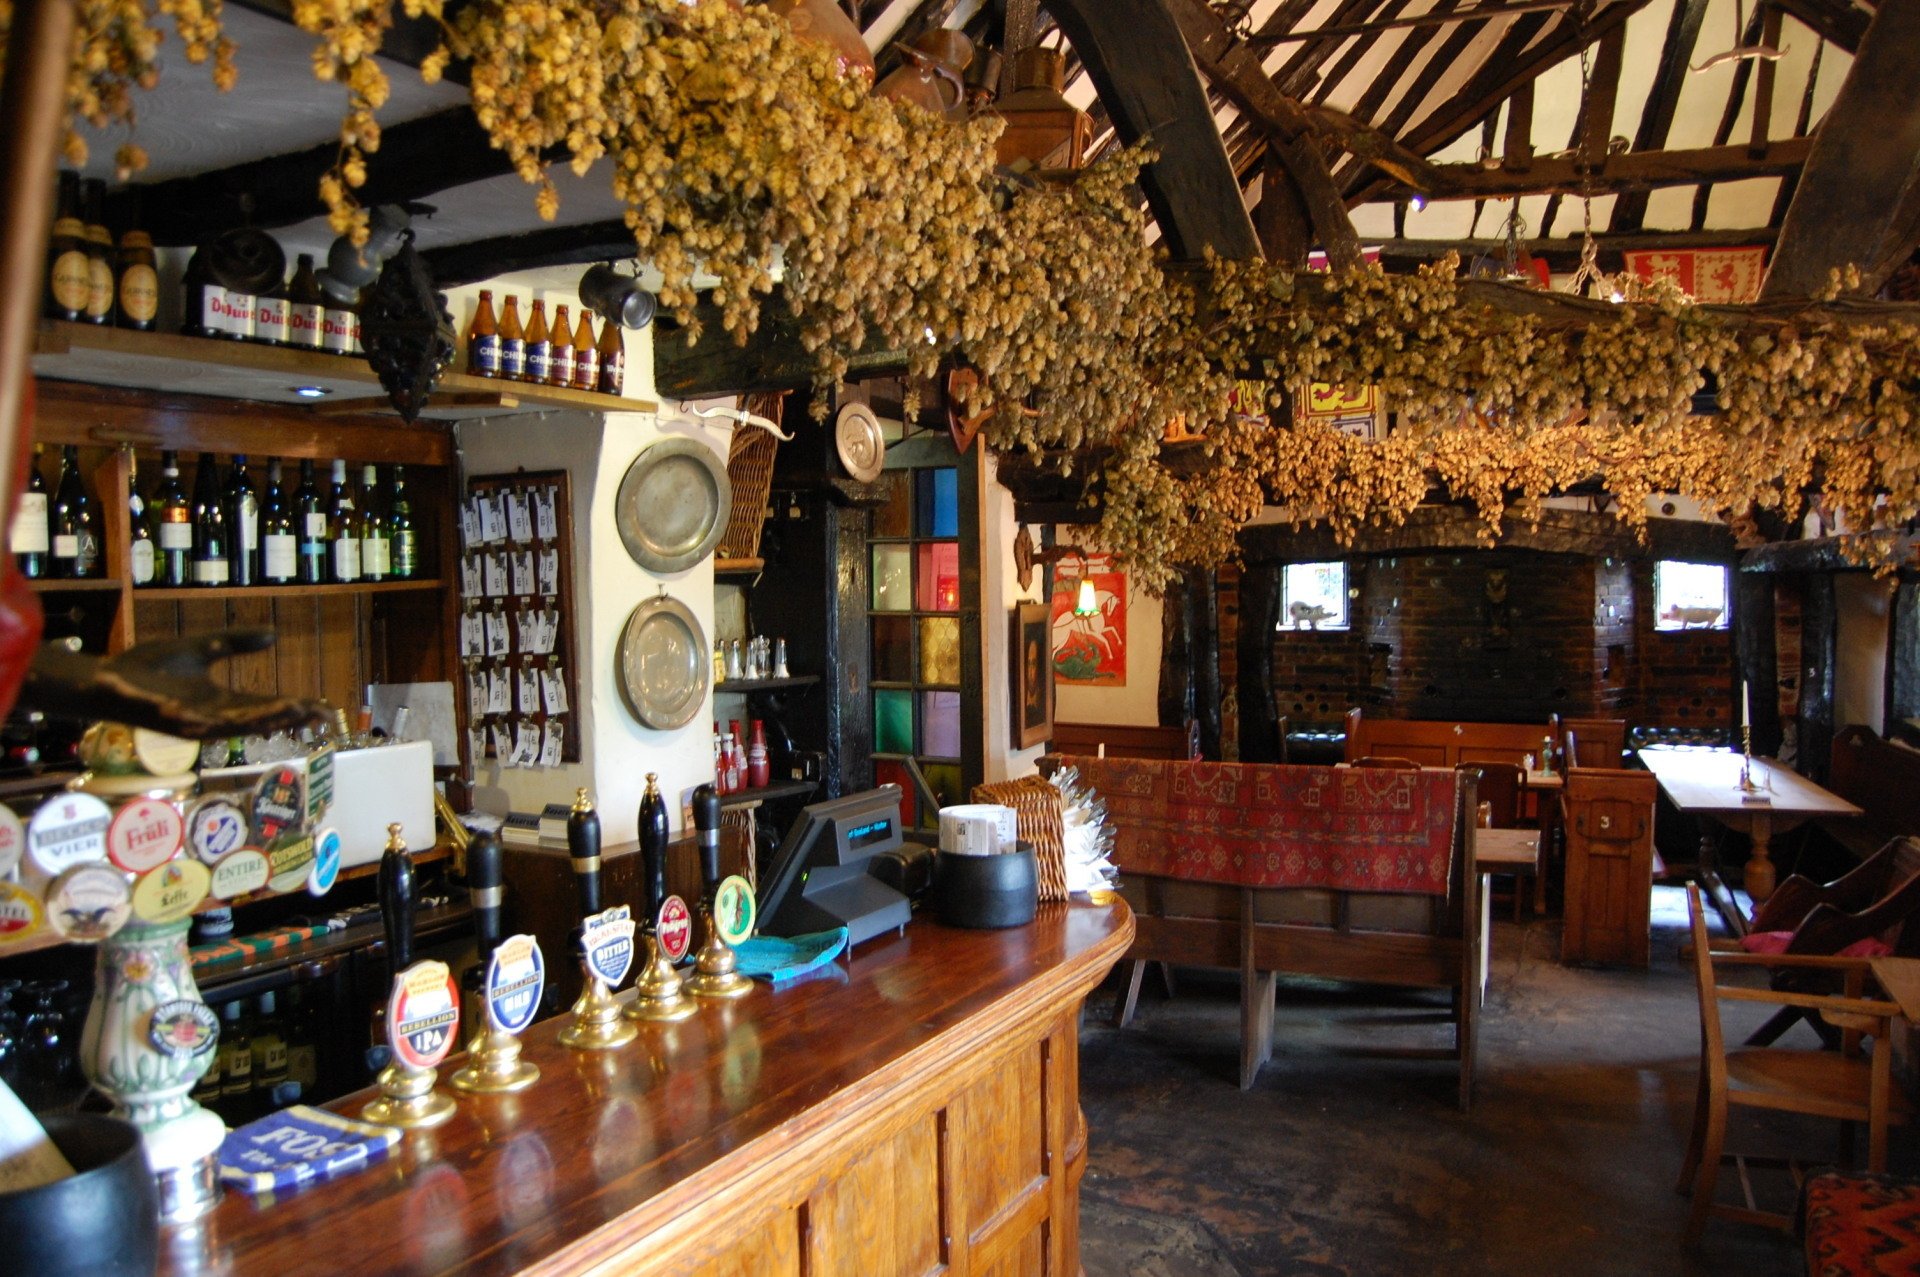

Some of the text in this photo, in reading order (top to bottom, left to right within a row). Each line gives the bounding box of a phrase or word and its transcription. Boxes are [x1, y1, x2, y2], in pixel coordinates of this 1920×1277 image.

[1601, 816, 1610, 828] 3
[126, 819, 170, 850] Früli
[51, 838, 98, 857] VIER
[218, 859, 264, 881] ENTIRE
[596, 940, 630, 962] BITTER
[401, 1012, 455, 1034] REBELLION
[415, 1029, 443, 1051] IPA
